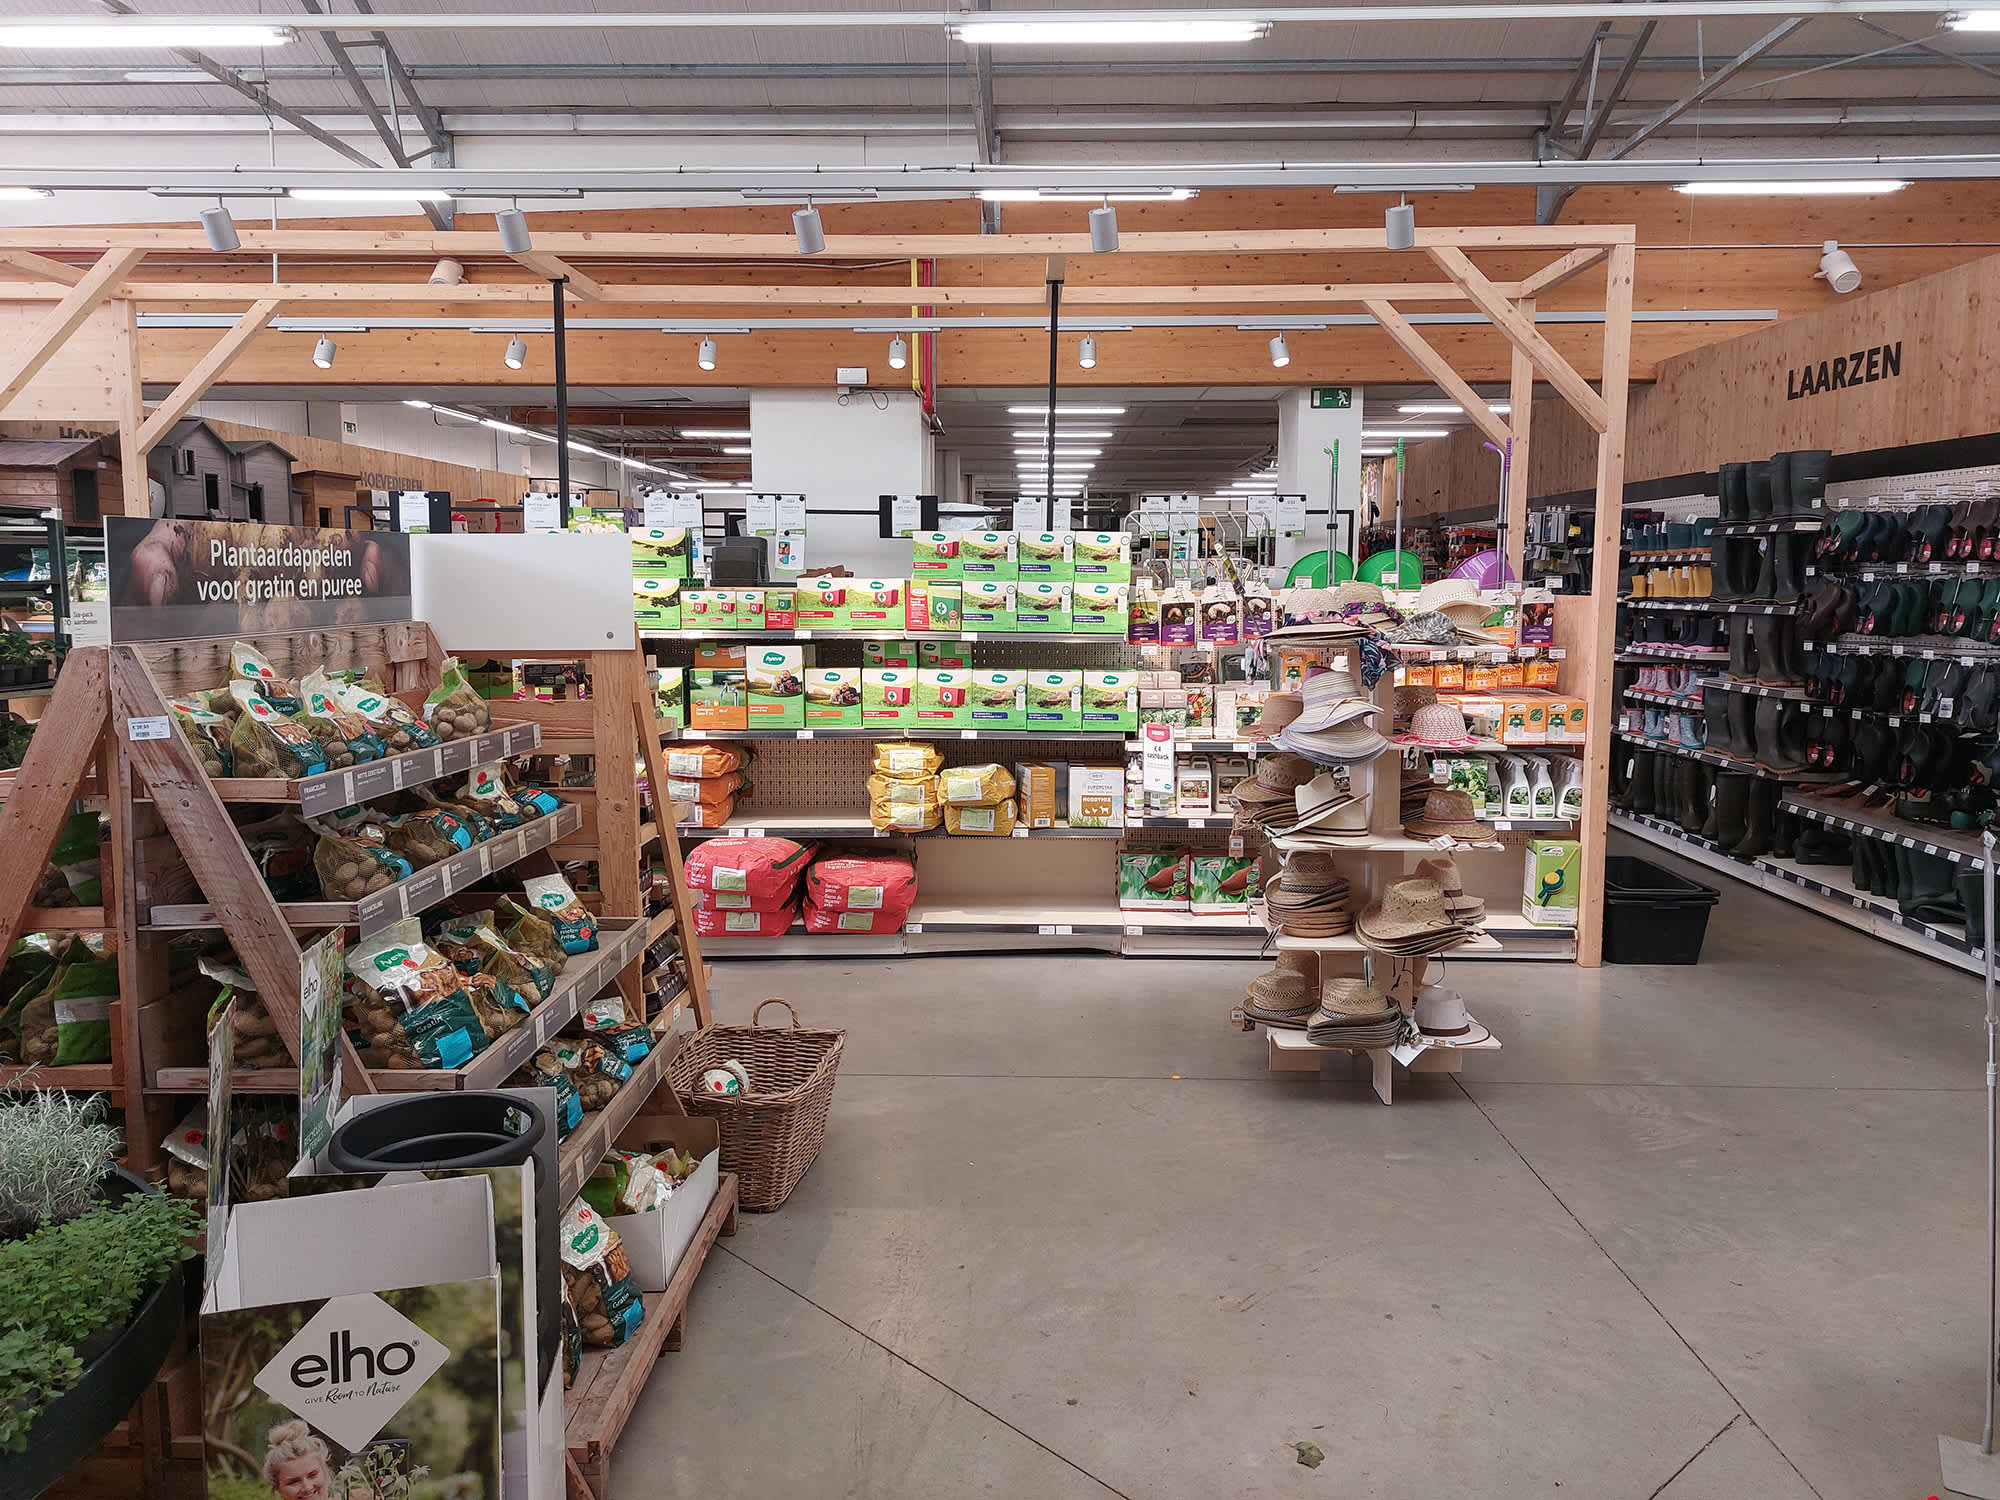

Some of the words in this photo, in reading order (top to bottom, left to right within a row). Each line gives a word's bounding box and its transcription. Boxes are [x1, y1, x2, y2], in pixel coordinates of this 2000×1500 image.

[1787, 341, 1902, 401] LAARZEN
[360, 471, 423, 490] HOEVEDIEREN
[210, 539, 352, 572] Plantaardappelen
[197, 580, 241, 601] voor
[245, 574, 295, 606] gratin
[300, 578, 318, 598] en
[322, 577, 362, 602] puree
[1411, 668, 1433, 678] PROMO
[1440, 666, 1462, 677] PROMO
[1475, 669, 1498, 680] PROMO
[1500, 666, 1523, 676] PROMO
[303, 976, 318, 1000] elho
[290, 1330, 416, 1389] elho
[304, 1397, 327, 1405] GIVE
[325, 1387, 353, 1405] Room
[355, 1391, 365, 1399] TO
[366, 1380, 401, 1397] Nature
